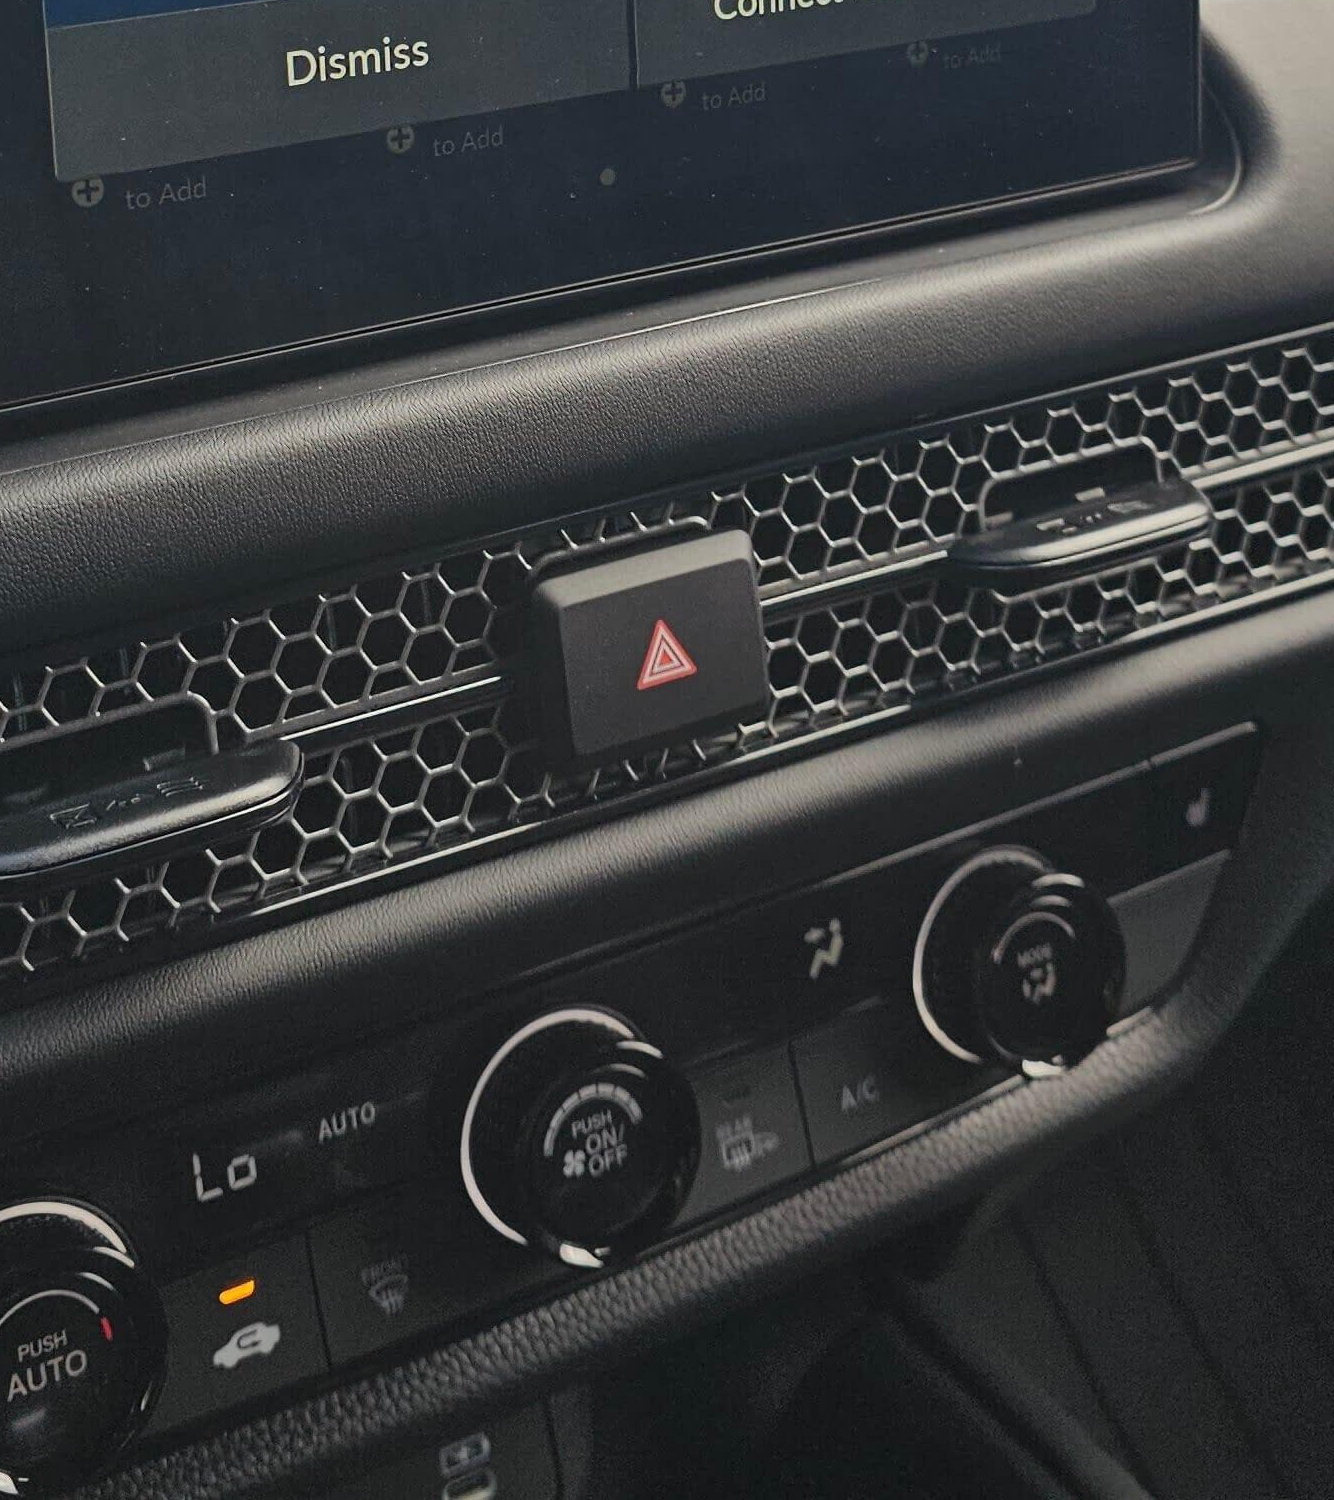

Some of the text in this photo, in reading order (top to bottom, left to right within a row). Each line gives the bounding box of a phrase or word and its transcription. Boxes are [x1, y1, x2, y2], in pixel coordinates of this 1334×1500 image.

[285, 36, 431, 87] Dismiss
[700, 81, 767, 110] to Add
[432, 124, 505, 157] to Add
[124, 175, 208, 210] to Add
[317, 1101, 377, 1143] AUTO
[571, 1109, 614, 1138] PUSH
[585, 1124, 626, 1155] ON/
[588, 1145, 629, 1176] OFF
[17, 1328, 69, 1362] PUSH
[6, 1349, 88, 1403] AUTO
